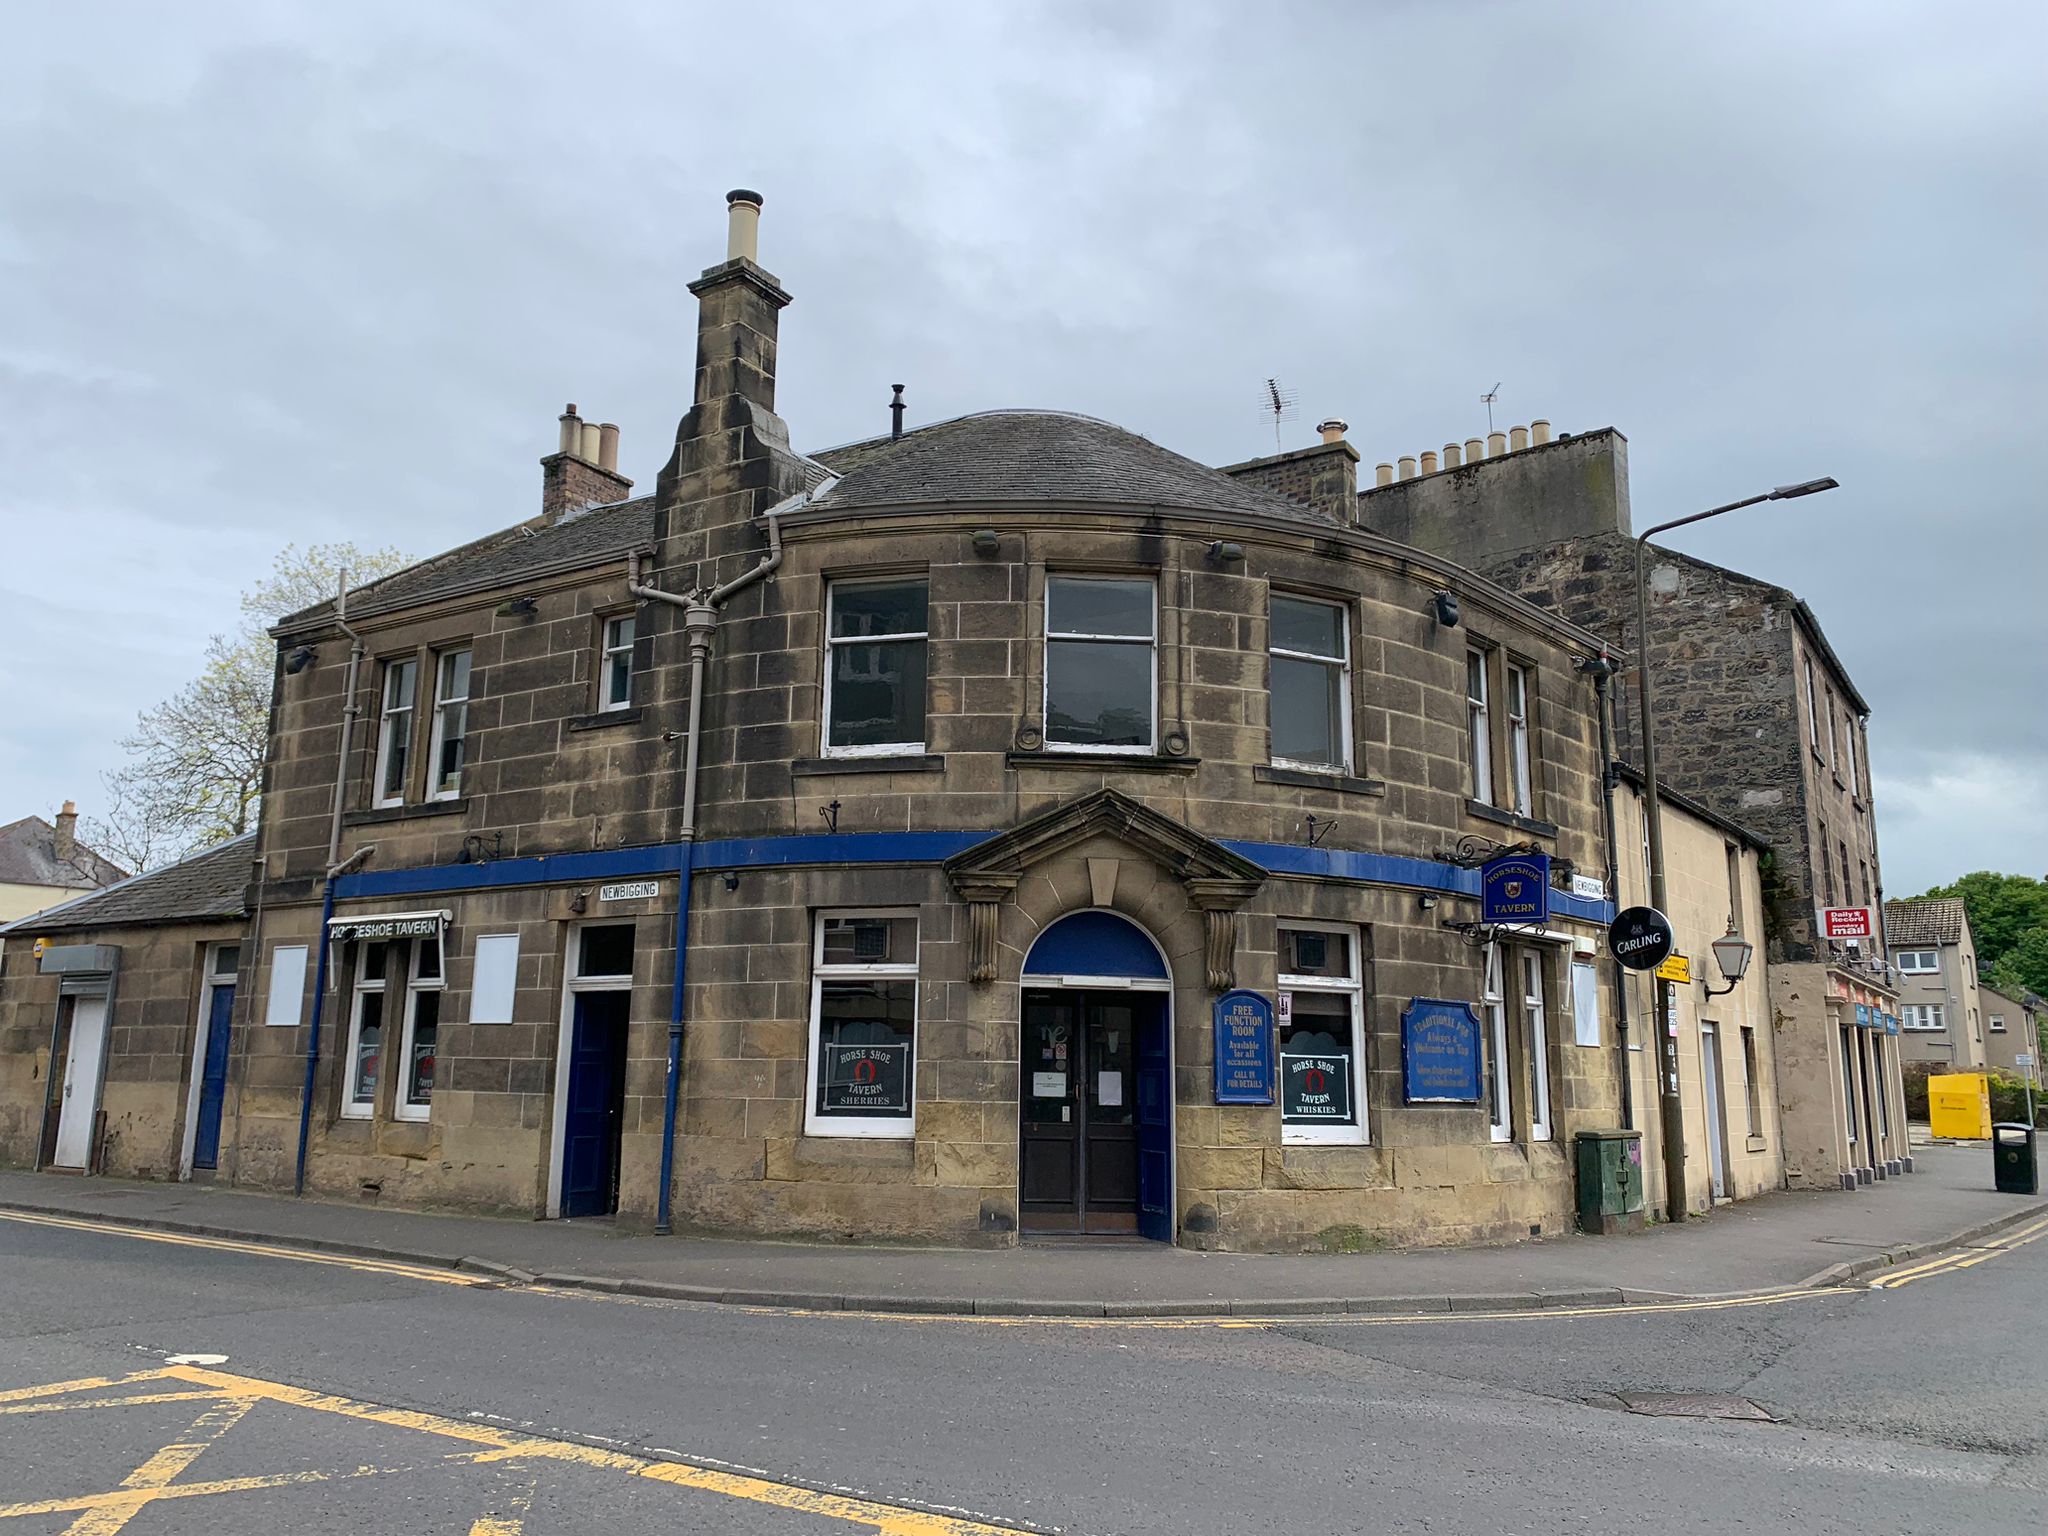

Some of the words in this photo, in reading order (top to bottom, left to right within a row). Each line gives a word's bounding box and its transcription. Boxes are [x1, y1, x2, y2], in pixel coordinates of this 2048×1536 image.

[1487, 866, 1540, 884] HORSESHOE
[602, 883, 656, 899] NEWBIGGING
[1494, 903, 1536, 914] TAVERN
[330, 922, 394, 939] HOESHOE
[395, 920, 436, 935] TAVERN
[1832, 924, 1865, 935] mail
[1617, 932, 1661, 954] CARLING
[1233, 1005, 1253, 1015] FREE
[1224, 1015, 1263, 1026] FUNCTION
[1232, 1026, 1255, 1037] ROOM
[1229, 1040, 1260, 1050] Available
[840, 1049, 866, 1064] HORSE
[870, 1049, 891, 1064] SHOE
[1234, 1049, 1244, 1058] for
[1245, 1049, 1255, 1058] all
[1292, 1060, 1315, 1074] HORSE
[1317, 1060, 1335, 1075] SHOE
[1234, 1070, 1248, 1079] CALL
[848, 1083, 883, 1095] TAVERN
[1226, 1079, 1239, 1088] FOR
[1239, 1079, 1263, 1089] DETAILS
[840, 1096, 890, 1105] SHERRIES
[1301, 1092, 1330, 1104] TAVERN
[1296, 1105, 1336, 1114] WHISKIES
